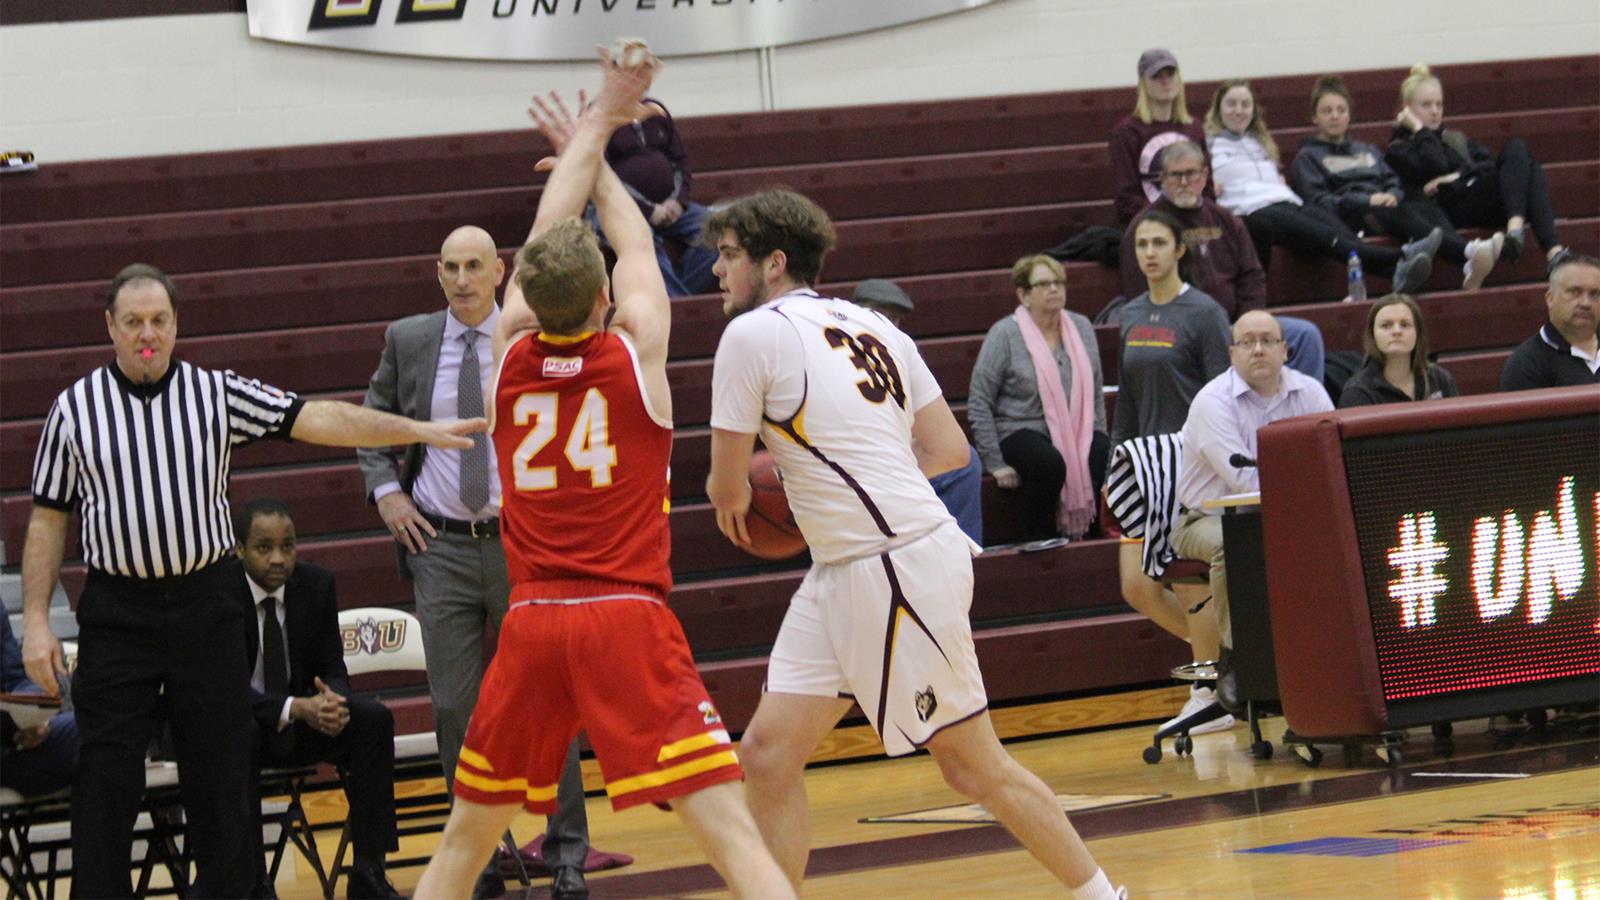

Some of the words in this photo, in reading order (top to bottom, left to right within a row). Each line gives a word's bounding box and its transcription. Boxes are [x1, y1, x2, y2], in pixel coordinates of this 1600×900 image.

[544, 360, 578, 370] PSAC
[823, 325, 907, 412] 30
[512, 387, 618, 491] 24
[1387, 475, 1600, 631] #UN
